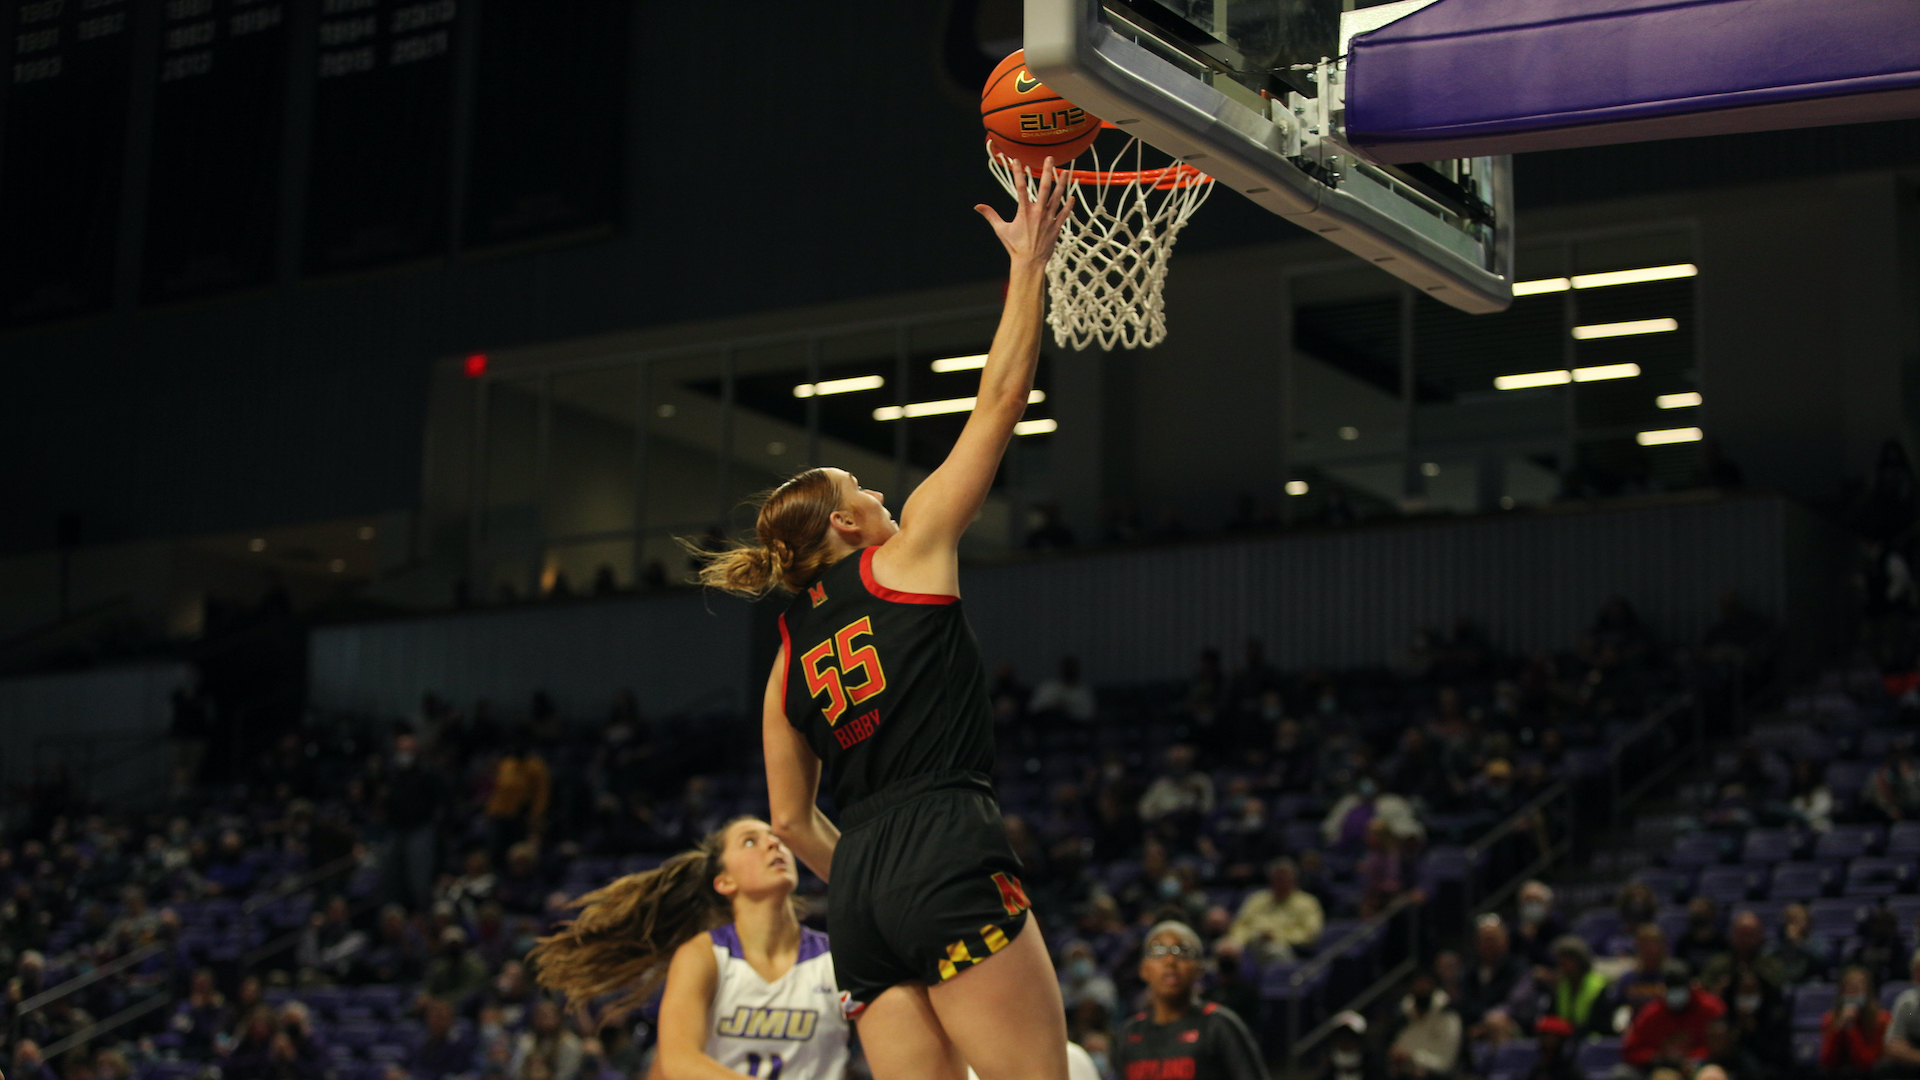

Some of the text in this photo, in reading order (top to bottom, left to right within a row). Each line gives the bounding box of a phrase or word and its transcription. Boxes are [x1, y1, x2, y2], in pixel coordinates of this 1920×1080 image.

[1019, 106, 1086, 132] ELITE
[807, 580, 829, 609] M
[800, 615, 887, 727] 55
[832, 708, 881, 750] BIBBY
[717, 1006, 819, 1041] JMU
